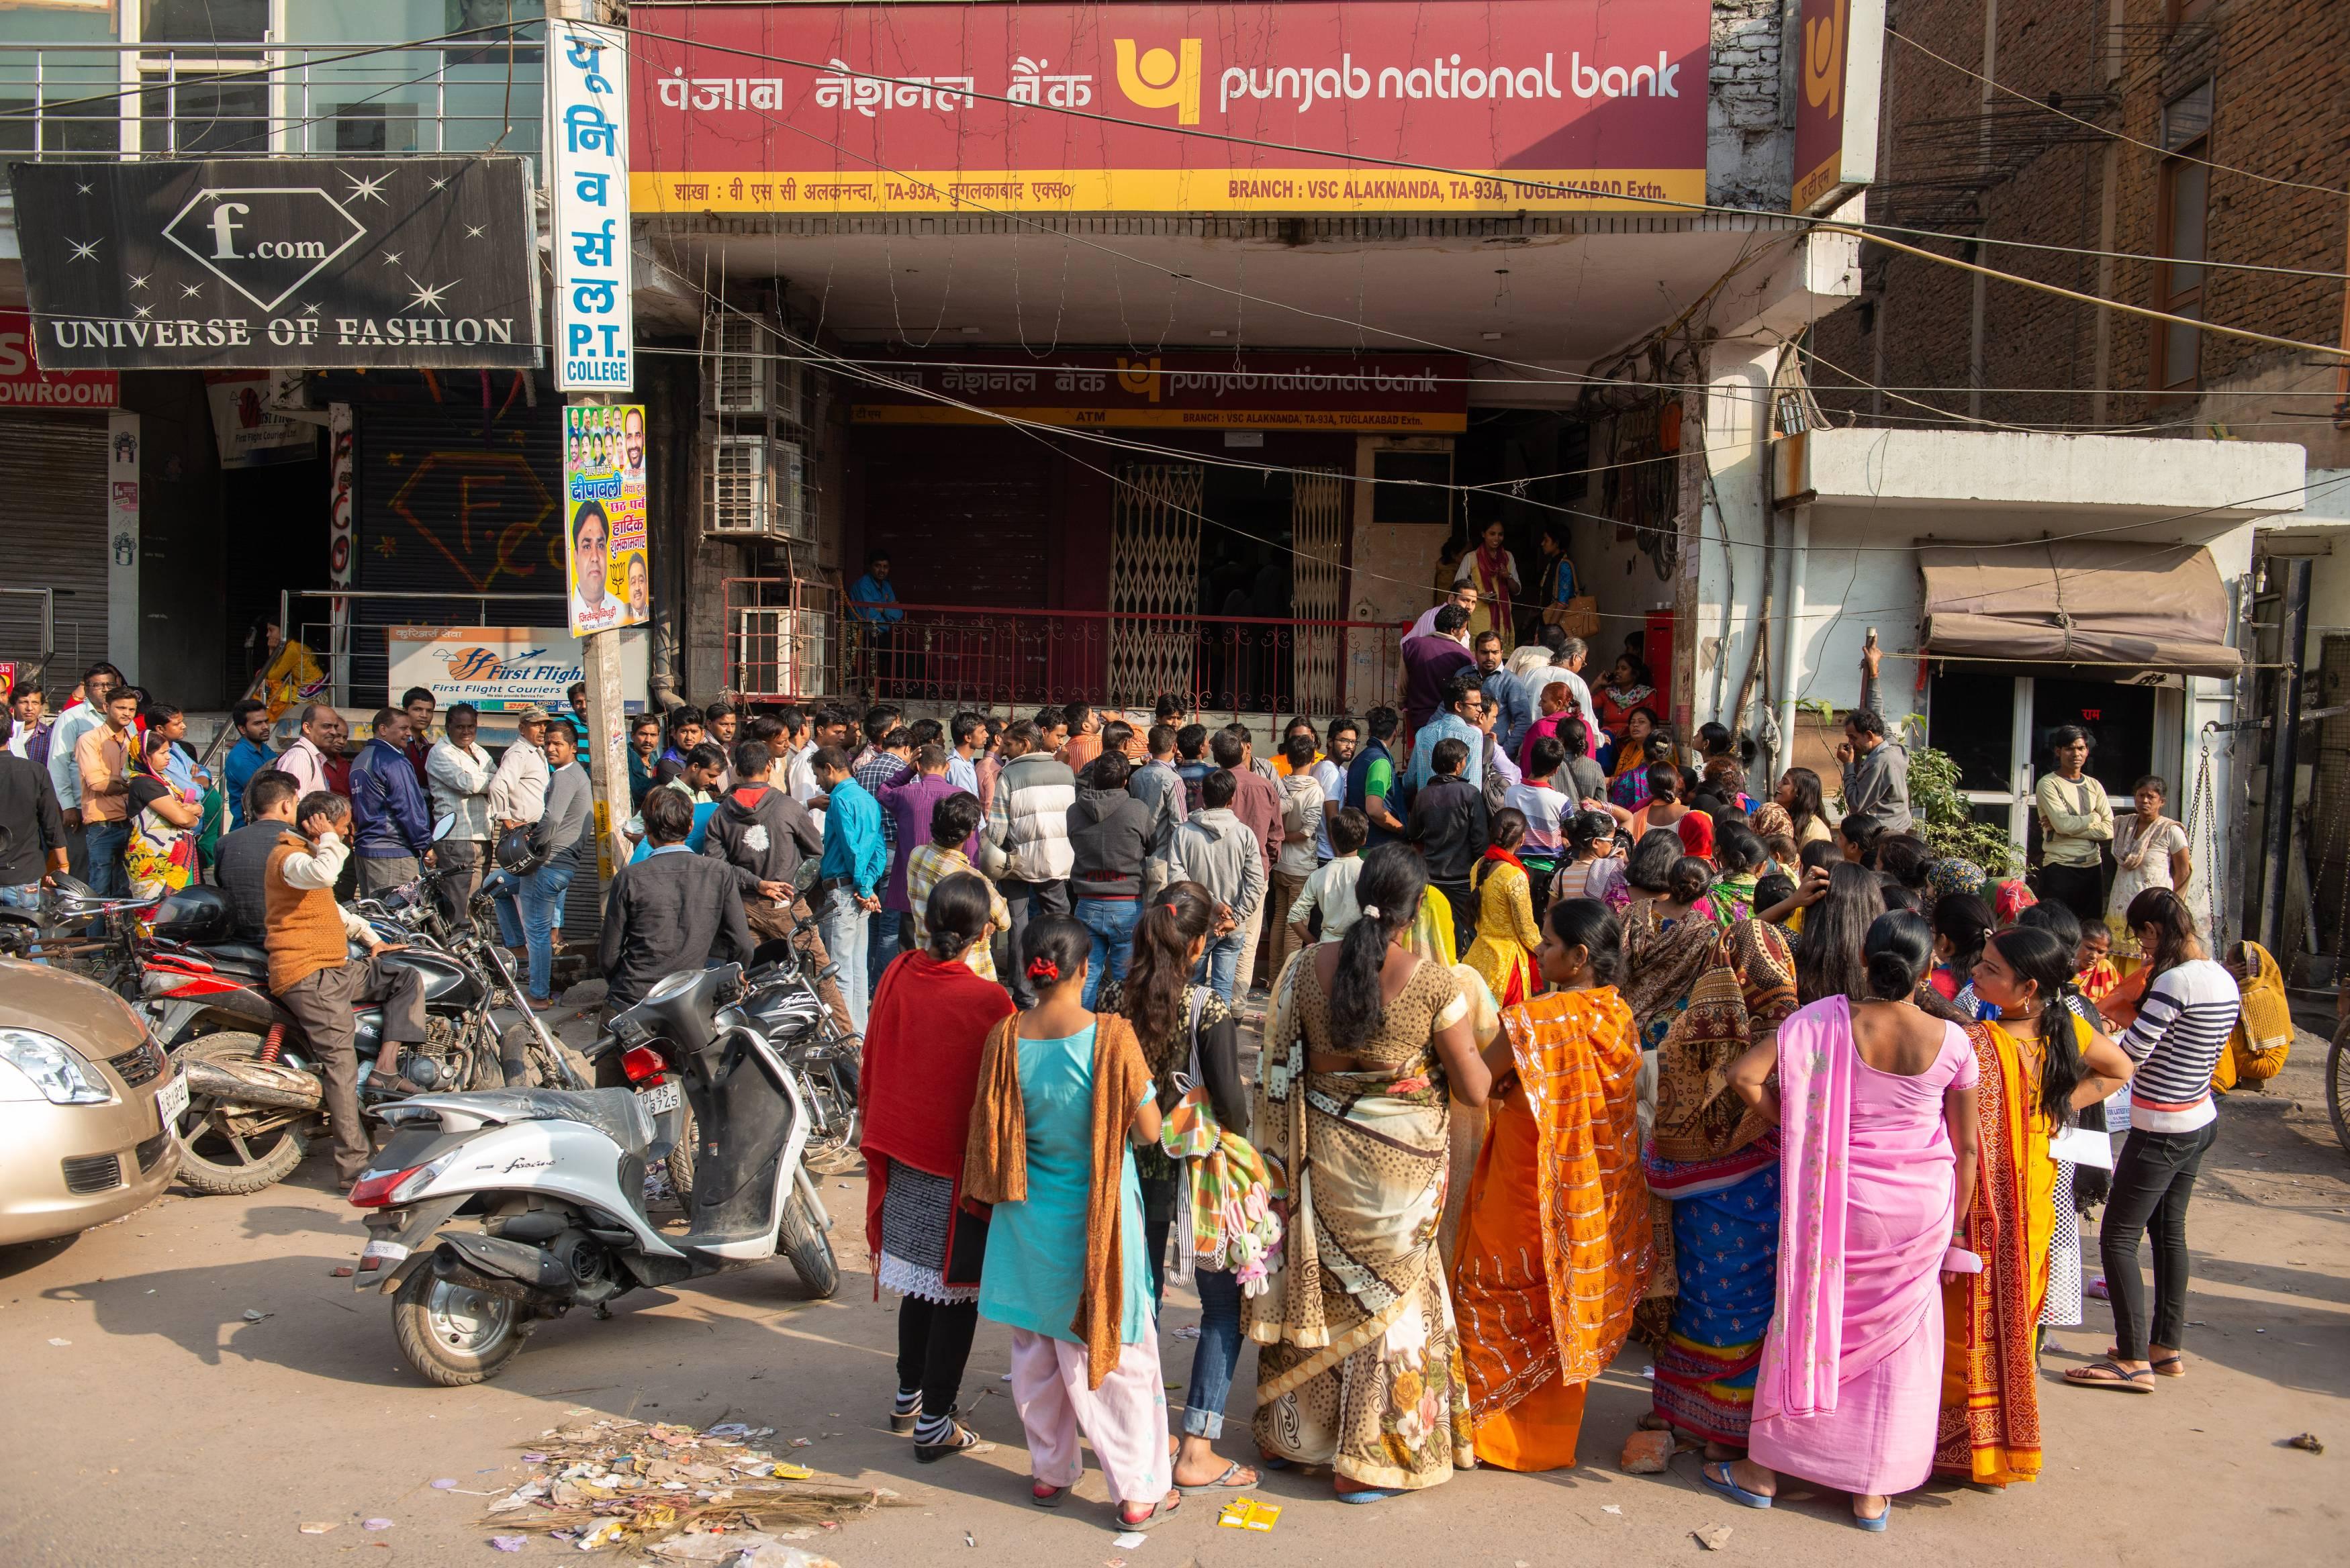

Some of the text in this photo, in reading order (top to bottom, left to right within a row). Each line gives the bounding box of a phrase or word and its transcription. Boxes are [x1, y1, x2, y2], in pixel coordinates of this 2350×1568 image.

[658, 66, 783, 111] पंजाब
[1006, 56, 1092, 107] बैंक
[1221, 51, 1680, 113] punjab national bank
[674, 183, 709, 200] शाखा
[729, 177, 743, 200] वी
[751, 183, 773, 204] एस
[780, 177, 797, 201] सी
[886, 183, 940, 203] TA-93A,
[949, 182, 1025, 207] तुगलकाबाद
[1229, 180, 1293, 198] BRANCH
[1308, 181, 1338, 199] VSC
[1343, 181, 1444, 203] ALAKNANDA,
[1450, 181, 1508, 203] TA-93A,
[1513, 181, 1622, 199] TUGLAKABAD
[1627, 181, 1666, 199] Extn.
[52, 317, 514, 348] UNIVERSE OF FASHION
[569, 324, 626, 358] P.T.
[567, 361, 626, 381] COLLEGE
[1170, 364, 1438, 397] punjab national bank
[1076, 411, 1107, 422] ATM
[1183, 413, 1220, 423] BRANCH
[1227, 414, 1244, 424] VSC
[1247, 414, 1302, 425] ALAKNANDA,
[1305, 415, 1337, 426] TA-93A,
[1340, 415, 1399, 425] TUGLAKABAD
[1401, 415, 1423, 426] Extn.
[571, 470, 622, 501] दीपावली
[610, 501, 627, 513] छठ
[612, 514, 644, 536] हार्दिक
[440, 628, 463, 639] सेवा
[487, 665, 528, 679] First
[432, 684, 561, 695] First Flight Couriers
